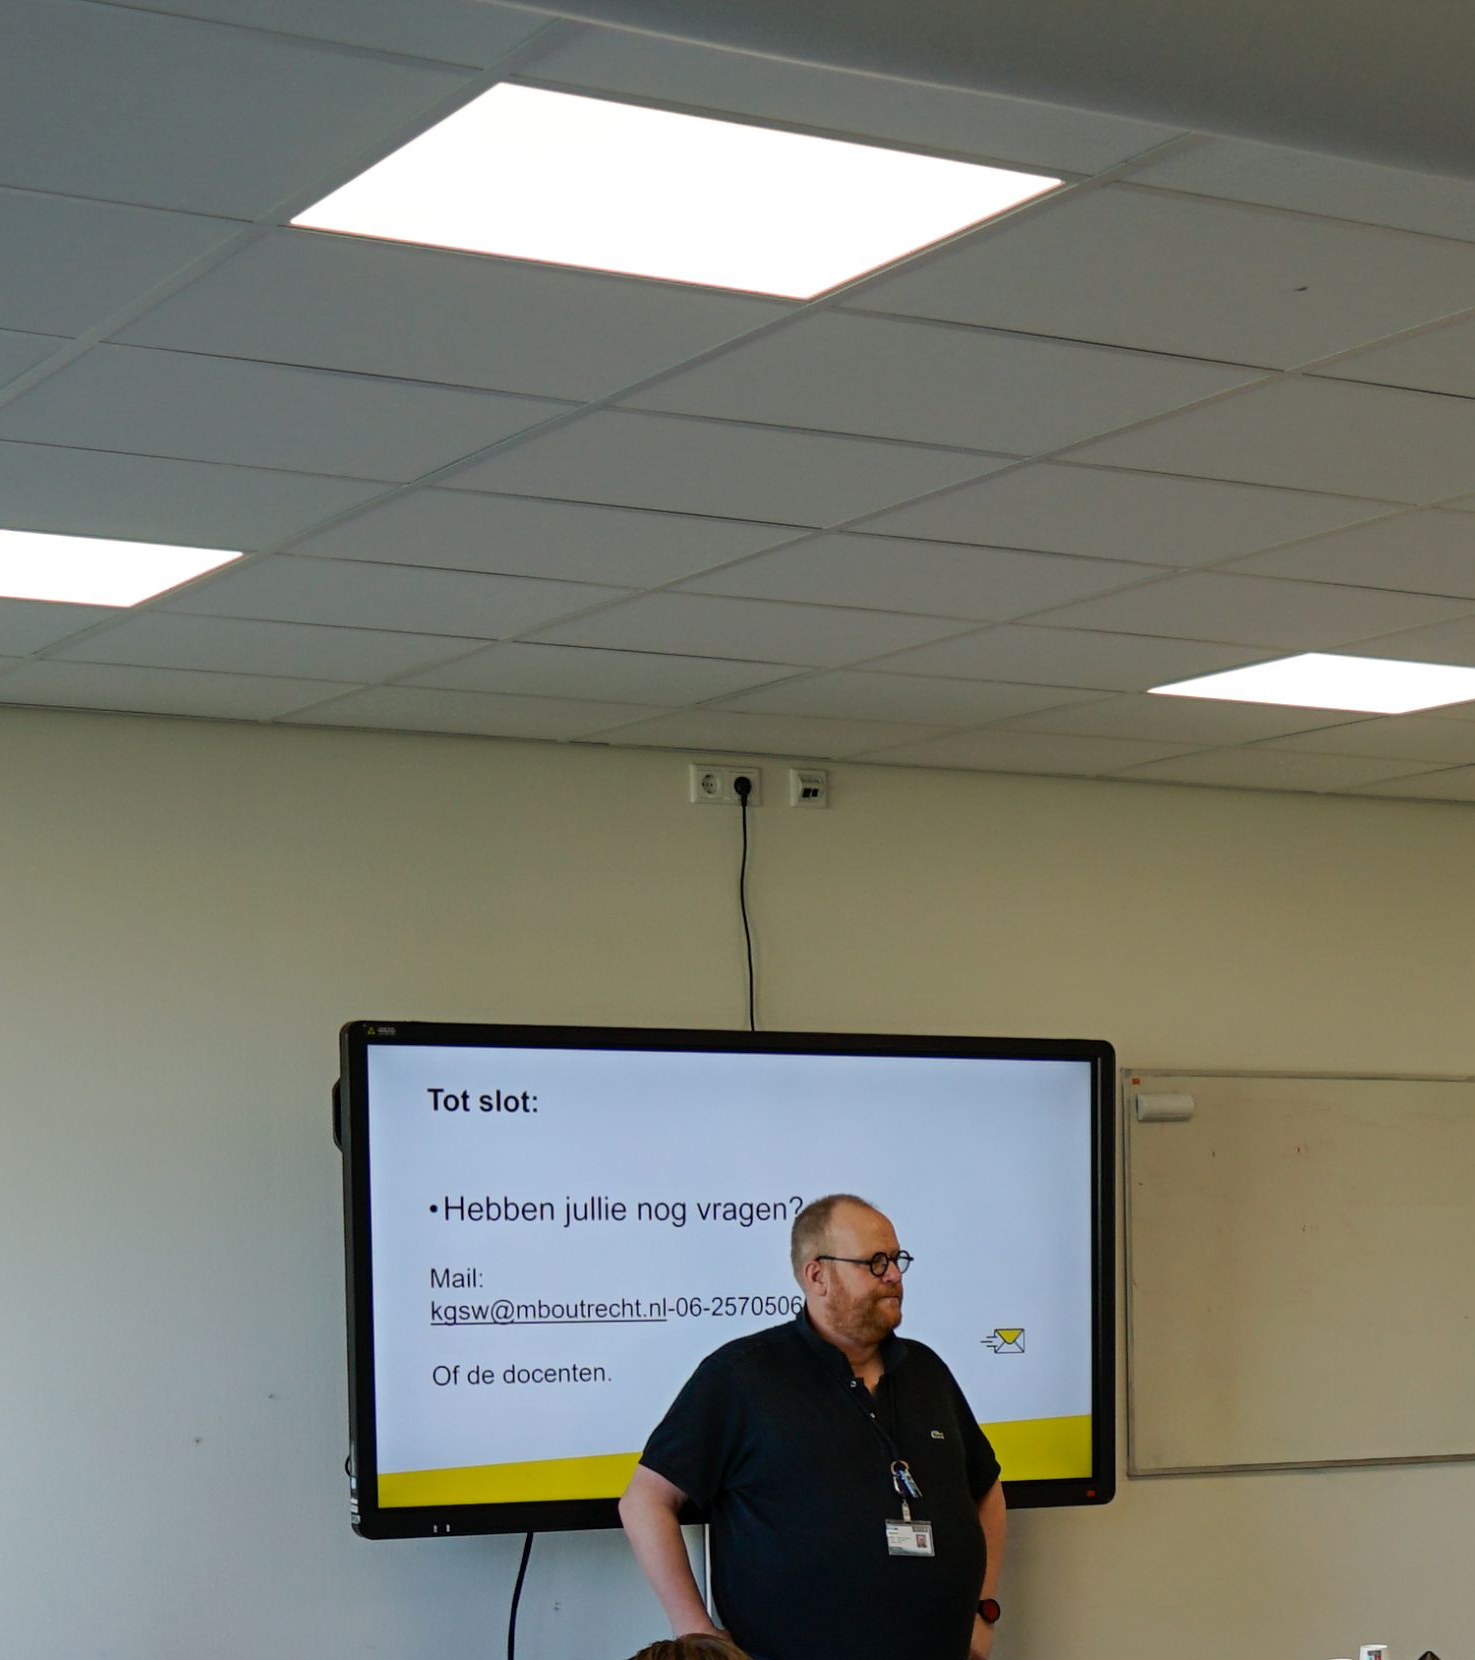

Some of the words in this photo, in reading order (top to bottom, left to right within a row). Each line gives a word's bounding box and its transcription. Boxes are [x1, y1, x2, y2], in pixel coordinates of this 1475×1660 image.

[427, 1088, 470, 1112] Tot
[478, 1089, 539, 1113] slot:
[443, 1196, 555, 1221] Hebben
[563, 1196, 627, 1228] jullie
[637, 1201, 686, 1227] nog
[696, 1196, 804, 1227] vragen?
[429, 1268, 484, 1289] Mail:
[432, 1365, 460, 1386] Of
[467, 1364, 495, 1385] de
[502, 1364, 613, 1384] docenten.
